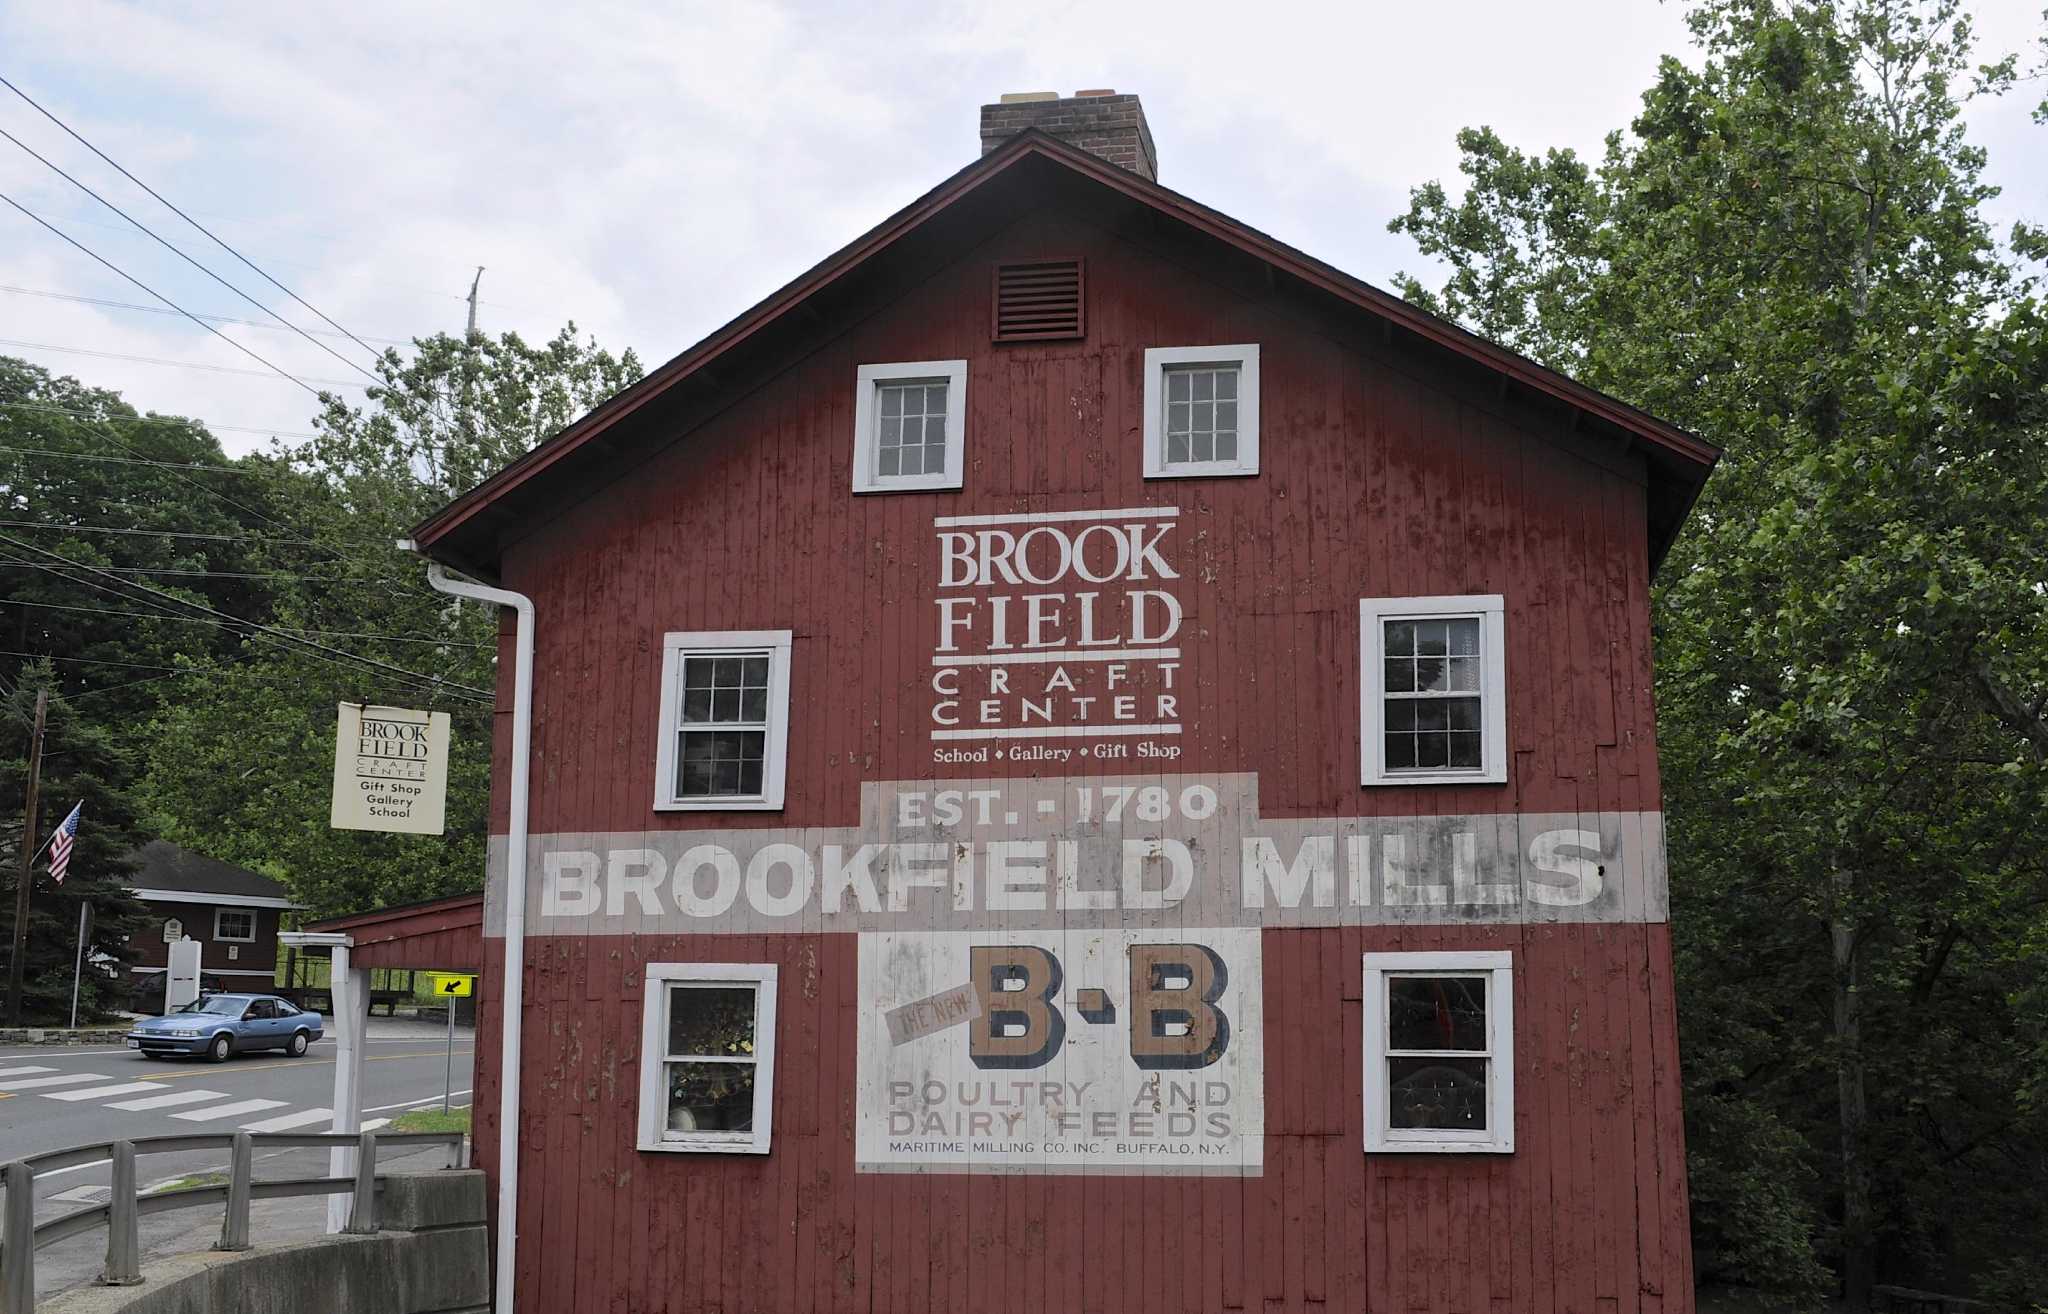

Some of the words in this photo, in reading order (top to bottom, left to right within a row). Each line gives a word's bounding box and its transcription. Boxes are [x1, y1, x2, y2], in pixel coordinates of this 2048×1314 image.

[936, 522, 1180, 587] BROOK
[935, 590, 1183, 651] FIELD
[932, 663, 1180, 694] CRAFT
[931, 695, 1178, 724] CENTER
[361, 721, 429, 742] BROOK
[360, 738, 428, 758] FIELD
[933, 748, 988, 763] School
[1009, 745, 1072, 762] Gallery
[1094, 743, 1128, 758] Gift
[1137, 740, 1181, 760] Shop
[356, 766, 425, 778] CENTER
[357, 758, 427, 770] CRAFT
[361, 781, 384, 792] Gift
[391, 784, 421, 796] Shop
[367, 794, 413, 808] Gallery
[369, 806, 410, 818] School
[898, 790, 1018, 827] EST.
[1077, 785, 1217, 823] 1780
[541, 837, 1194, 917] BROOKFIELD
[1242, 829, 1603, 908] MILLS
[898, 1001, 930, 1036] THE
[930, 992, 968, 1025] NEW
[888, 1080, 1092, 1106] POULTRY
[1133, 1080, 1231, 1106] AND
[888, 1111, 1024, 1137] DAIRY
[1058, 1111, 1231, 1138] FEEDS
[889, 1142, 965, 1153] MARITIME
[973, 1142, 1034, 1153] MILLING
[1199, 1143, 1229, 1154] N.Y.
